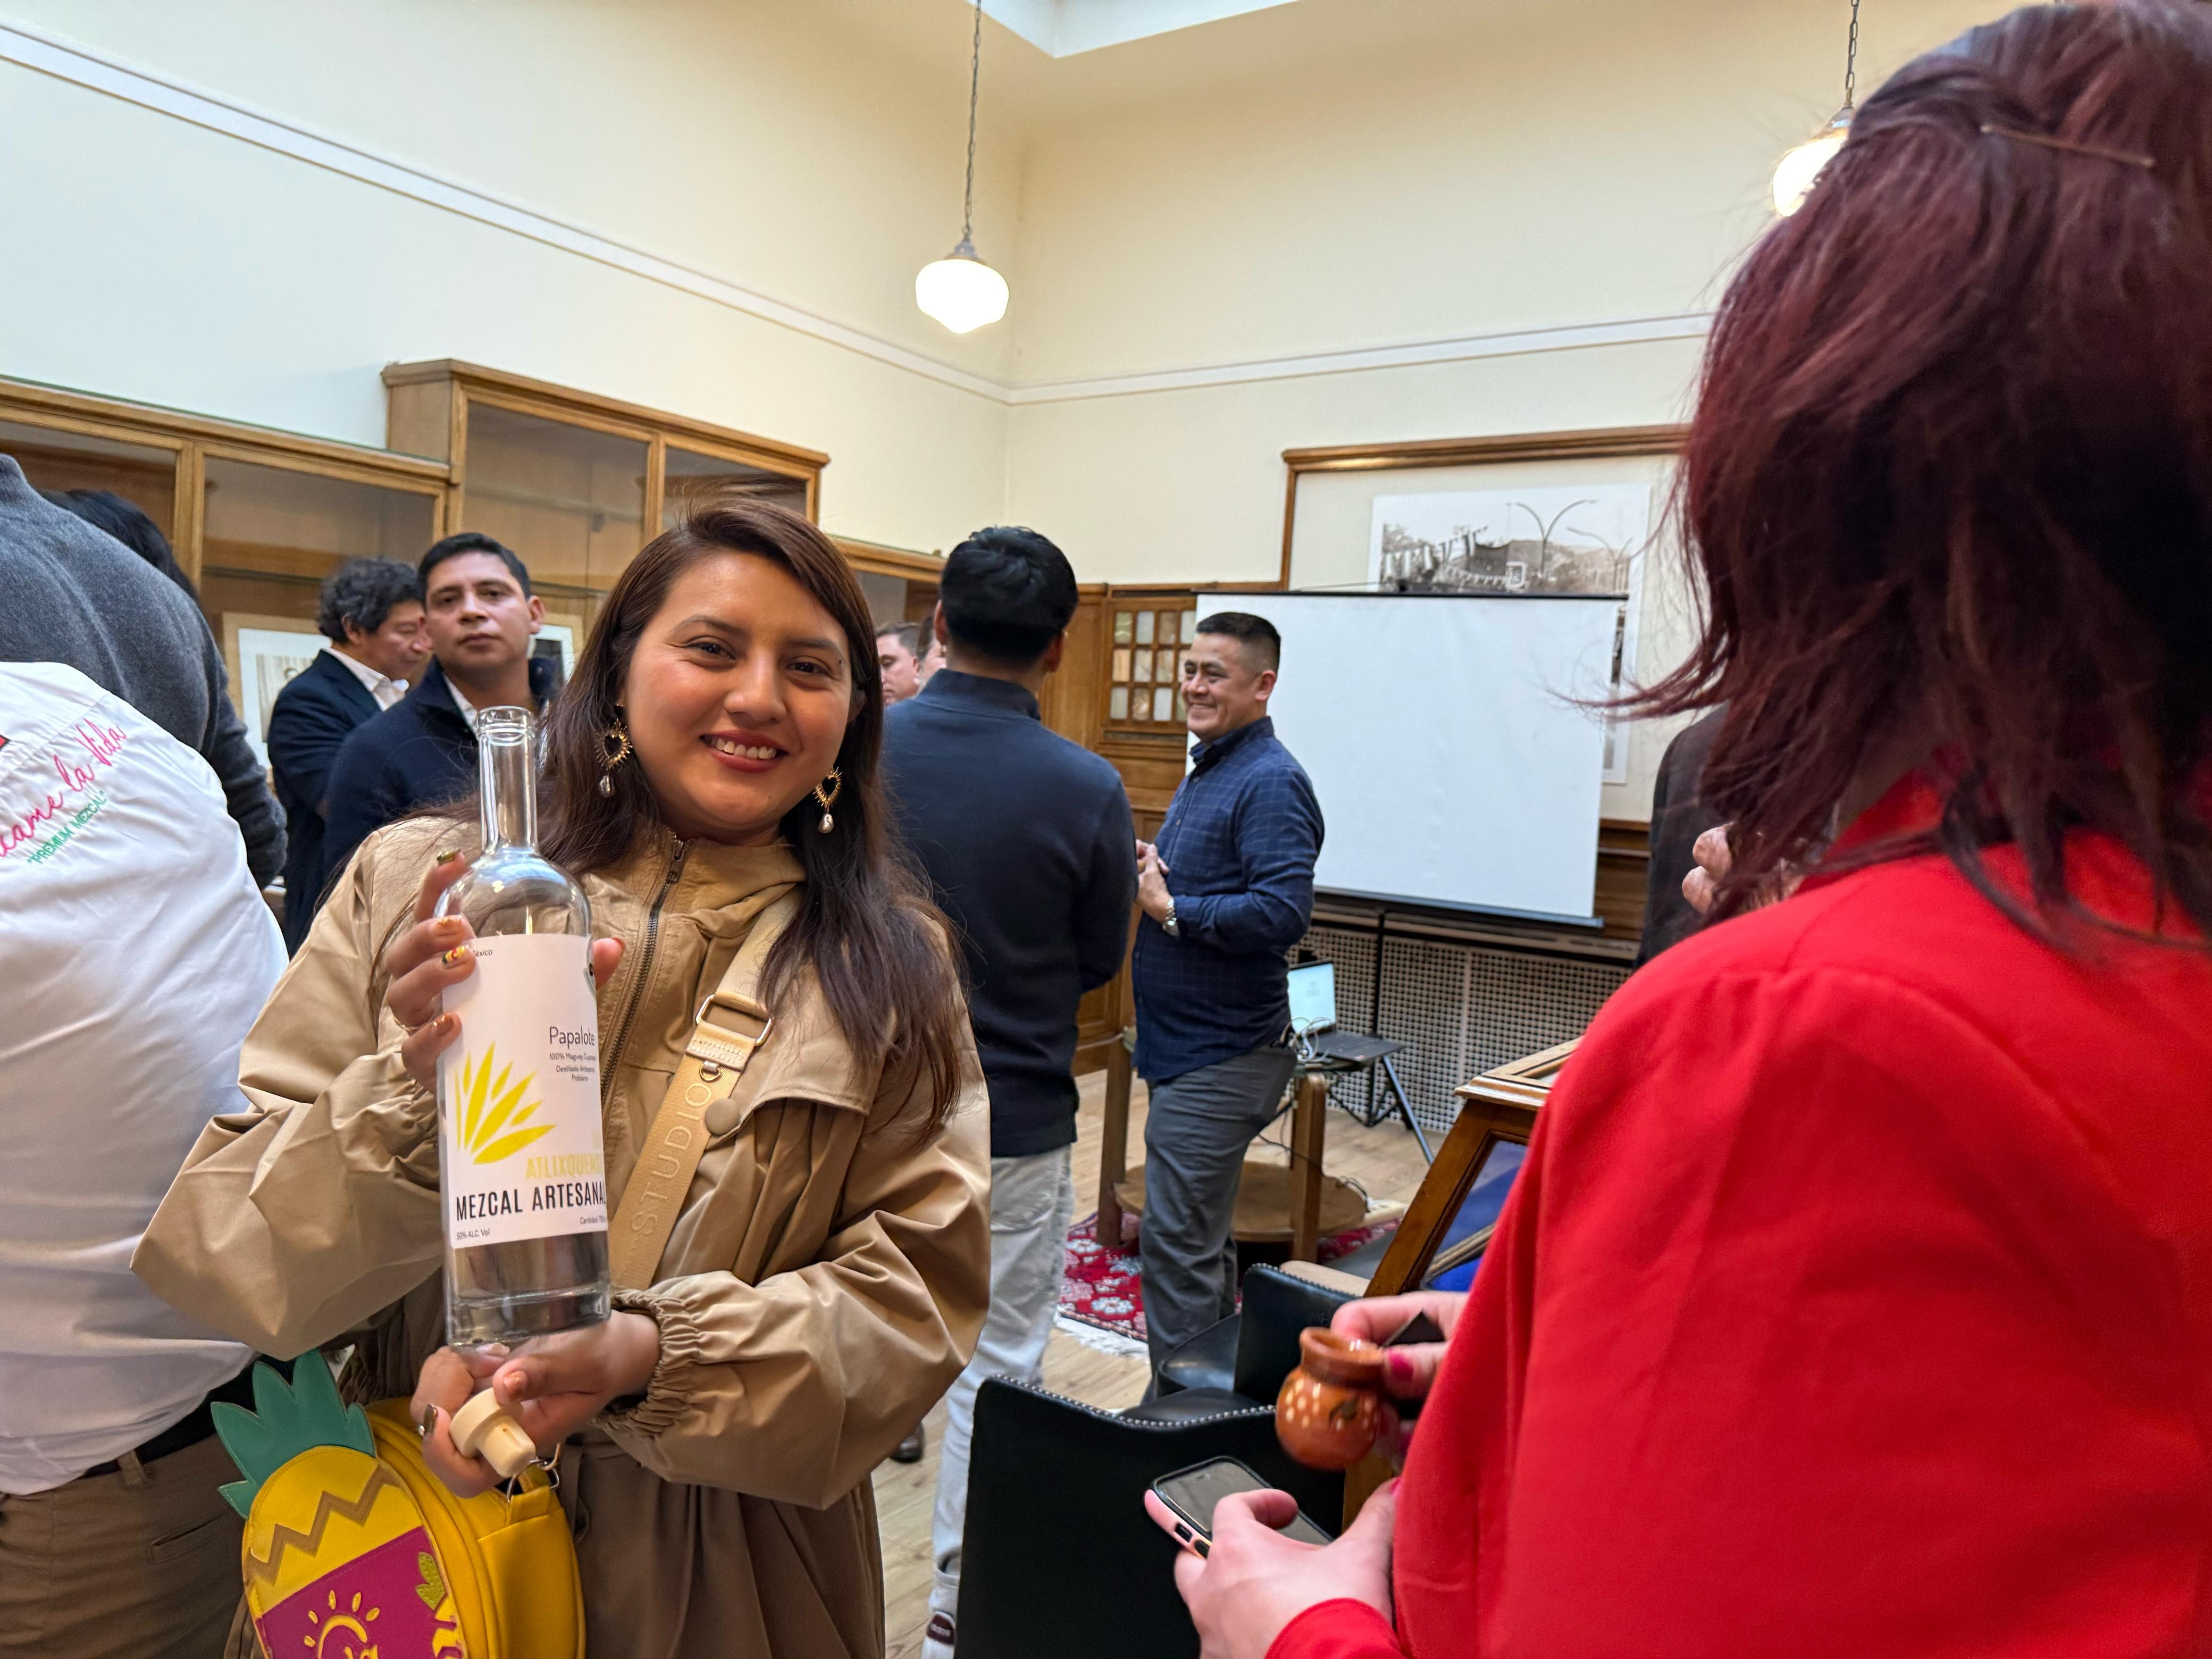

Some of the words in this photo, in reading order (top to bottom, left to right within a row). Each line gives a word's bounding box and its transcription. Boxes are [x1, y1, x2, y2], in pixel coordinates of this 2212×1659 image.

[73, 718, 127, 766] Vida
[55, 754, 95, 792] la
[473, 949, 492, 957] éxico
[549, 1025, 595, 1049] Papalote
[631, 1083, 712, 1236] STUDIO
[456, 1188, 523, 1221] MEZCAL
